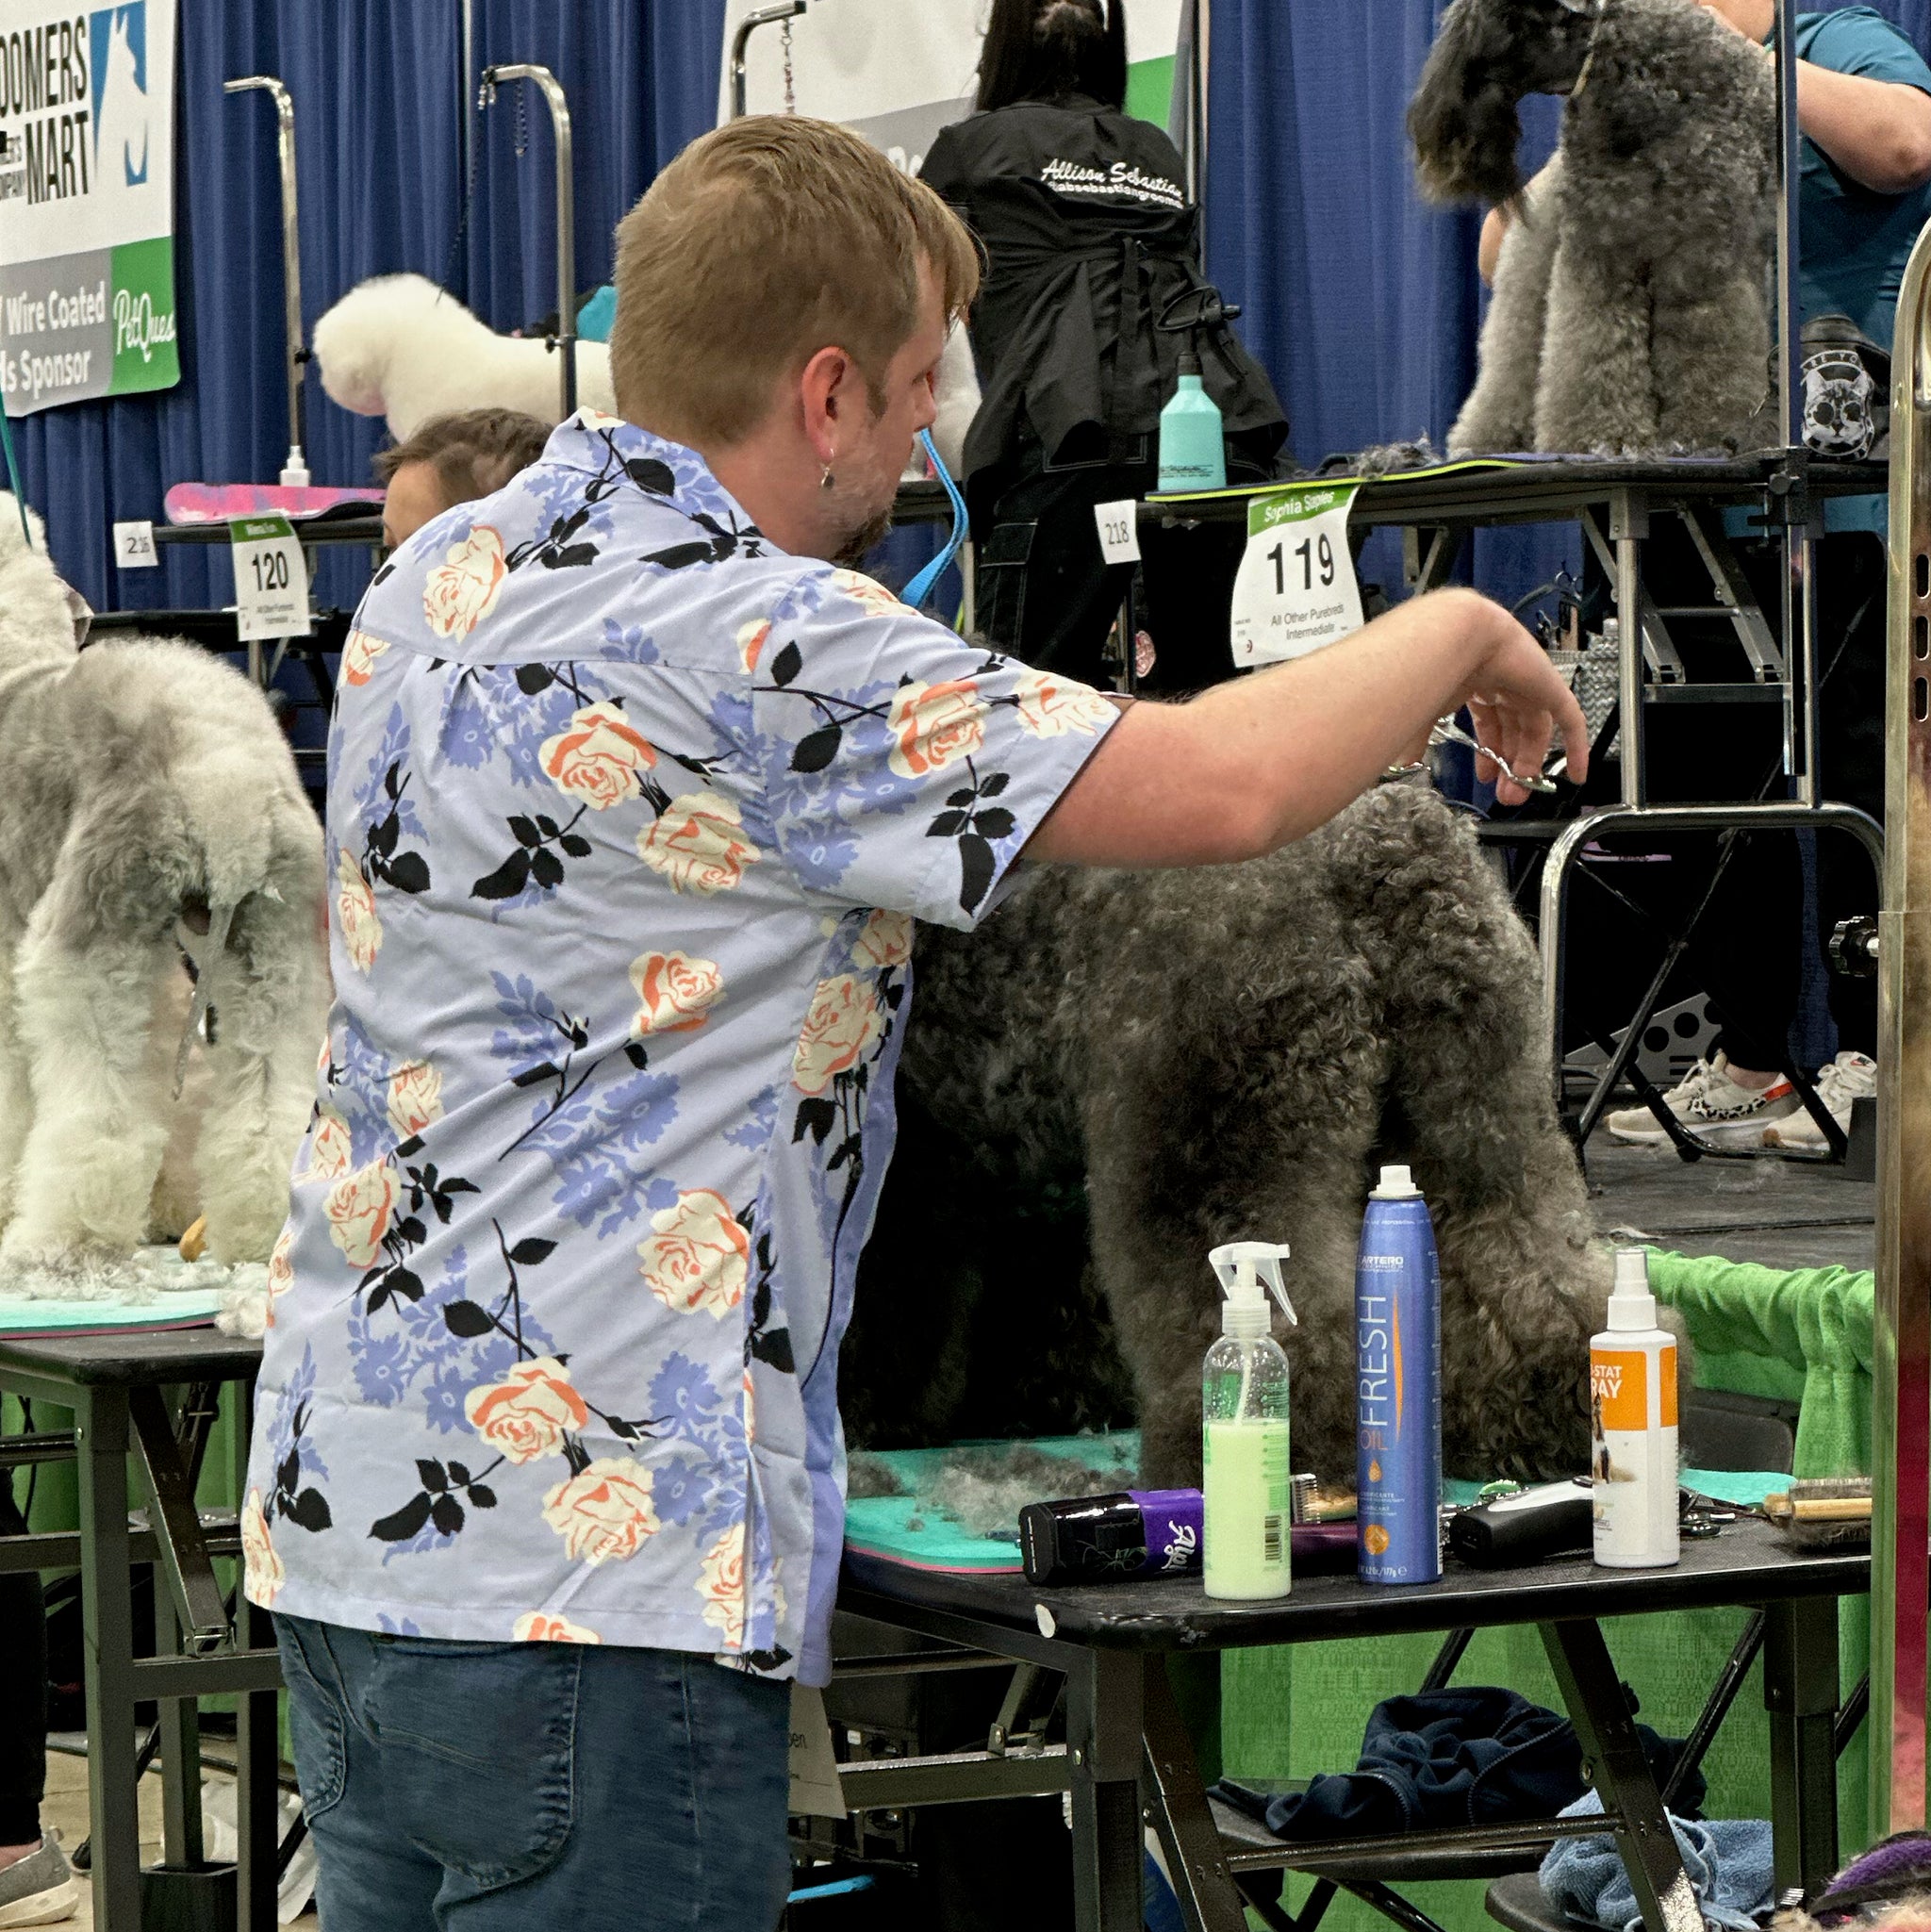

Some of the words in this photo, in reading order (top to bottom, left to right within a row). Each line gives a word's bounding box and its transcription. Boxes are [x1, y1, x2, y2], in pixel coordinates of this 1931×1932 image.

[25, 110, 89, 205] MART
[1041, 158, 1105, 182] Allison
[7, 291, 45, 335] Wire
[48, 280, 106, 330] Coated
[20, 350, 91, 400] Sponsor
[1106, 520, 1130, 545] 218
[252, 551, 289, 591] 120
[1267, 533, 1334, 595] 119
[1270, 615, 1281, 626] All
[1283, 611, 1309, 625] Other
[1359, 1296, 1388, 1427] FRESH
[1591, 1377, 1623, 1399] RAY
[1360, 1428, 1389, 1450] OIL
